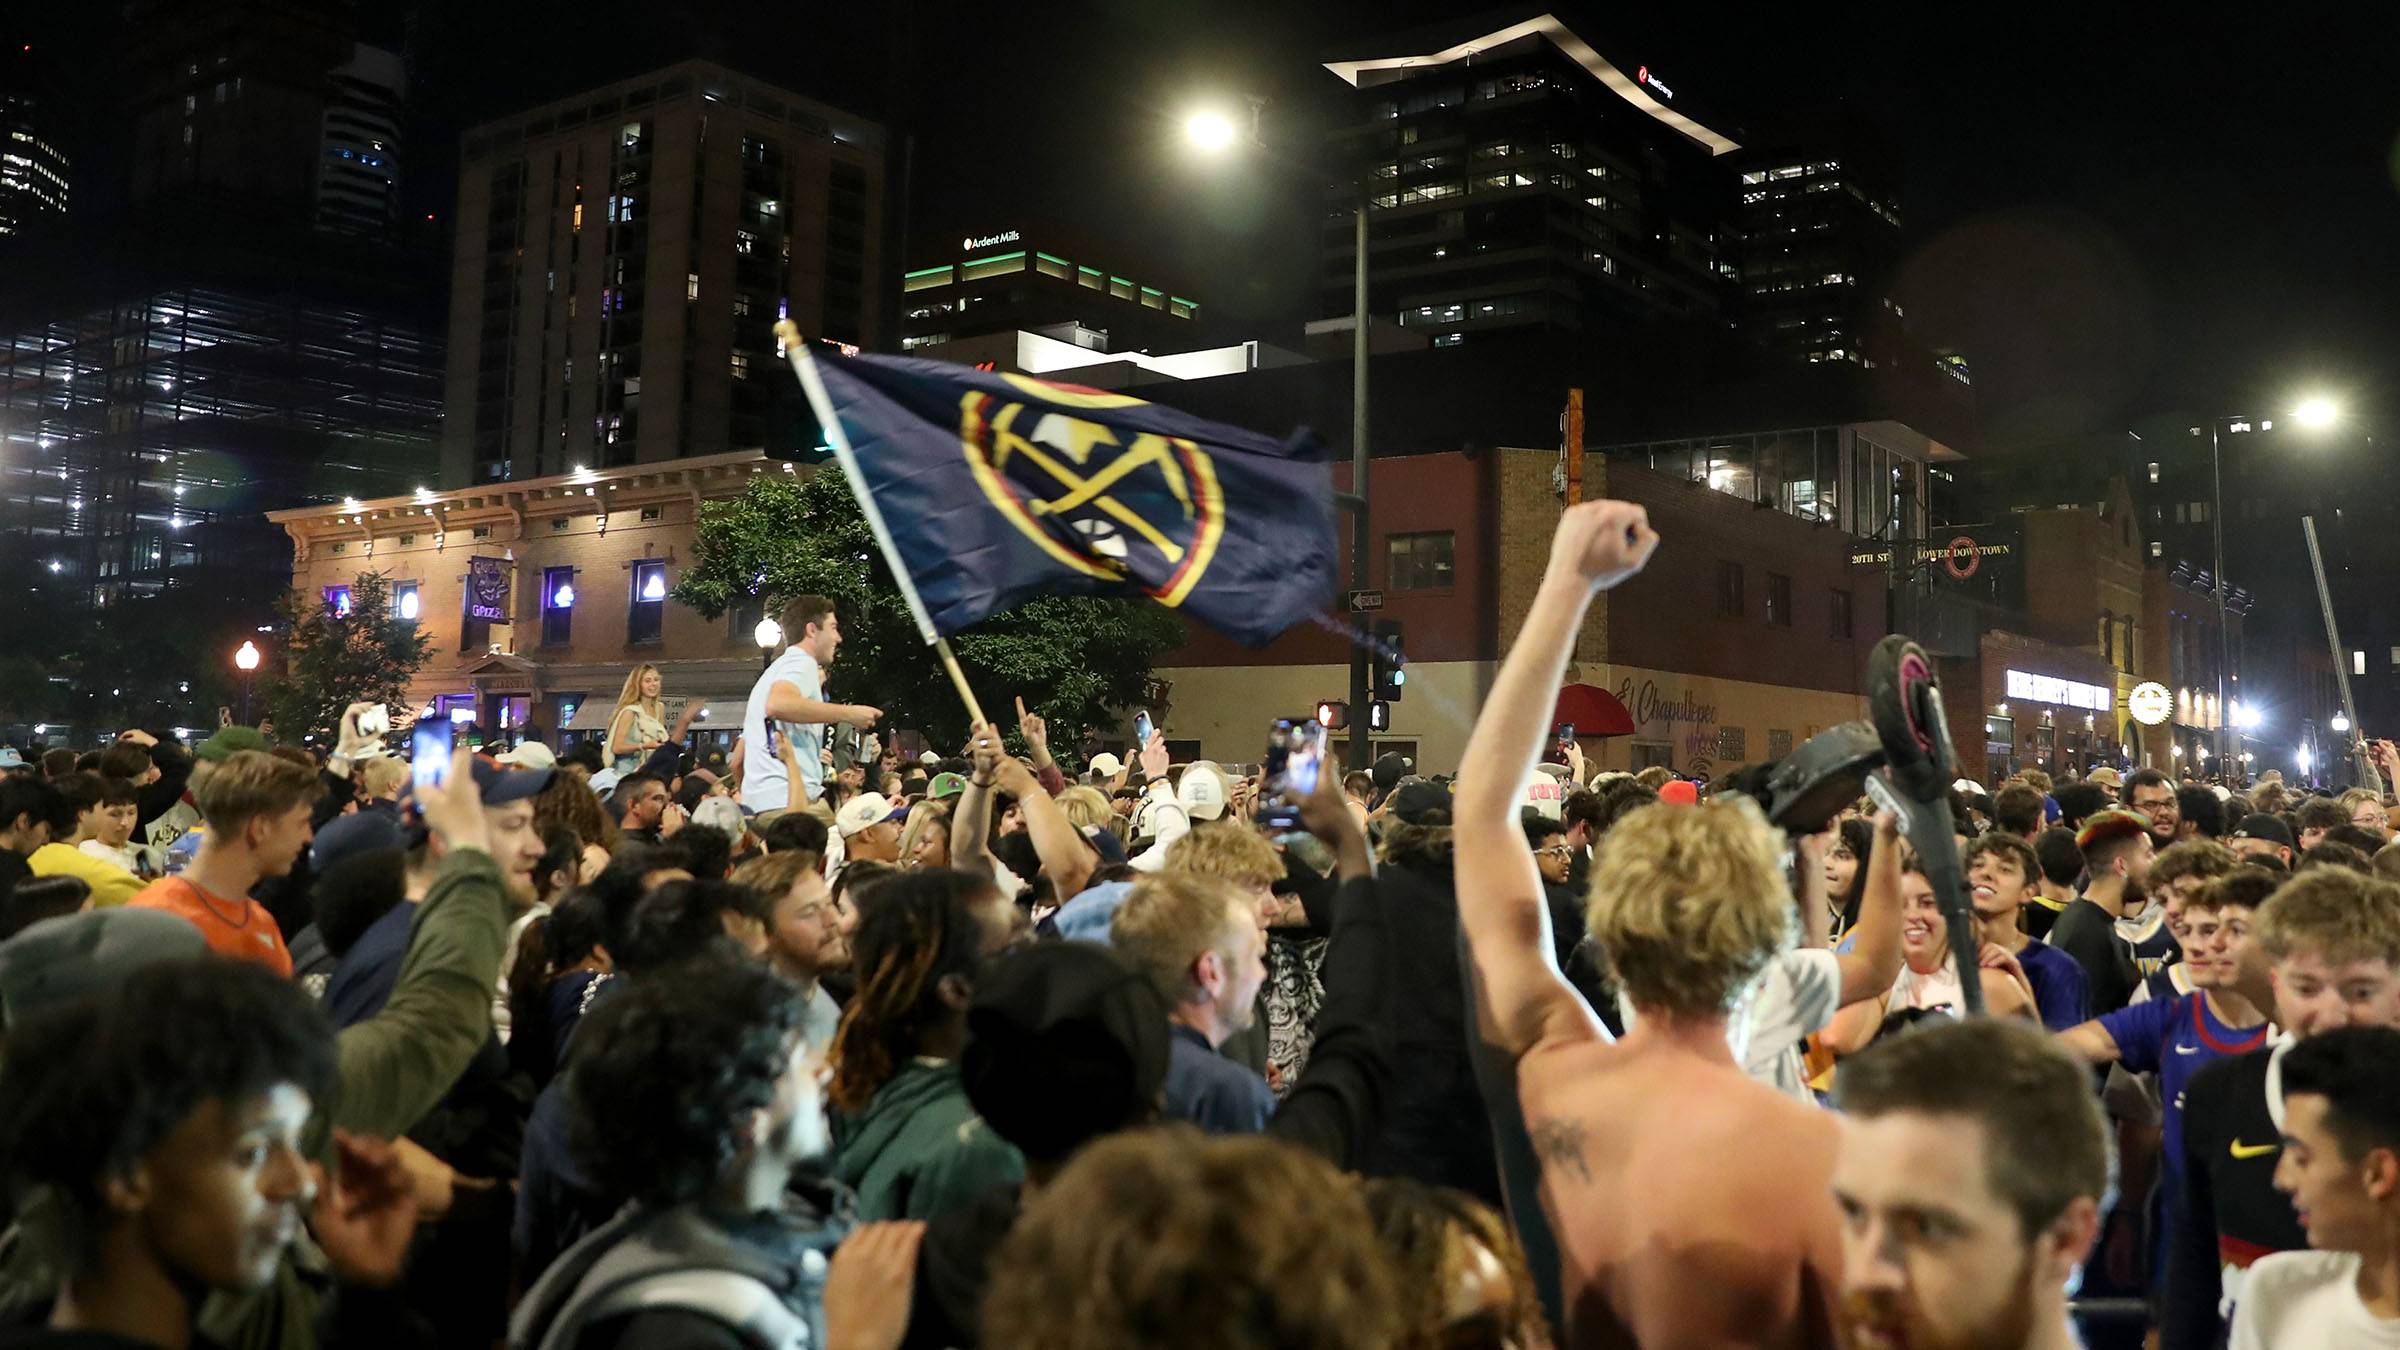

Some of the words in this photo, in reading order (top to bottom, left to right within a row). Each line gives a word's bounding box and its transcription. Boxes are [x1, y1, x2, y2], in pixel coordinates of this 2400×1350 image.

[972, 236, 999, 249] Ardent
[1000, 230, 1020, 243] Mills
[1852, 554, 1873, 564] 20TH
[1877, 553, 1889, 562] ST
[1917, 549, 1950, 560] LOWER
[1953, 544, 2009, 558] DOWNTOWN
[1638, 680, 1717, 734] Chapultepec
